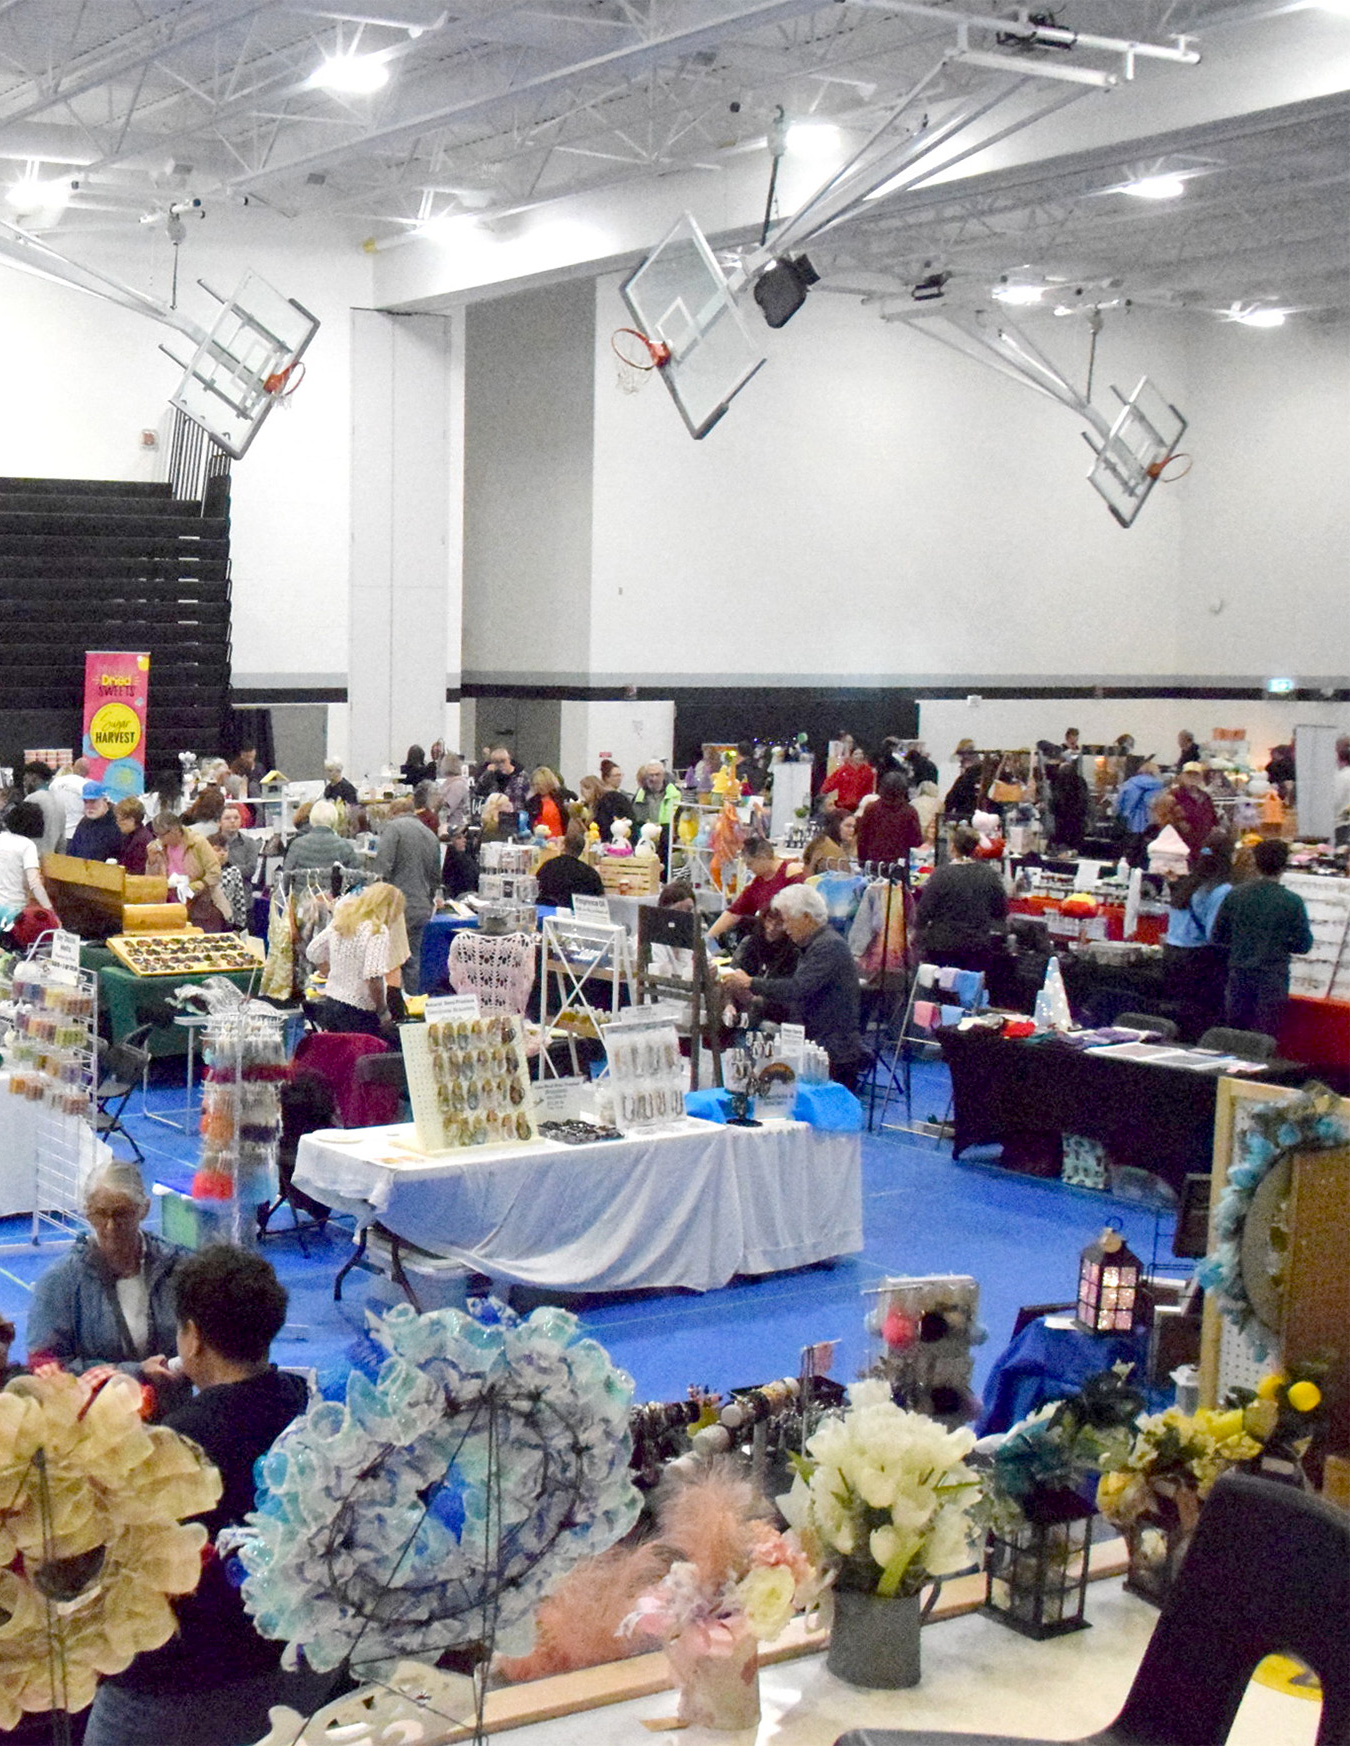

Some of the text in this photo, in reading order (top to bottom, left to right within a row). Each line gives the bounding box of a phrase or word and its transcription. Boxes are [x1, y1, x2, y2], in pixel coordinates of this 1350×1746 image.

[98, 685, 135, 697] SWEETS
[100, 711, 131, 732] Sugar
[95, 732, 135, 743] HARVEST
